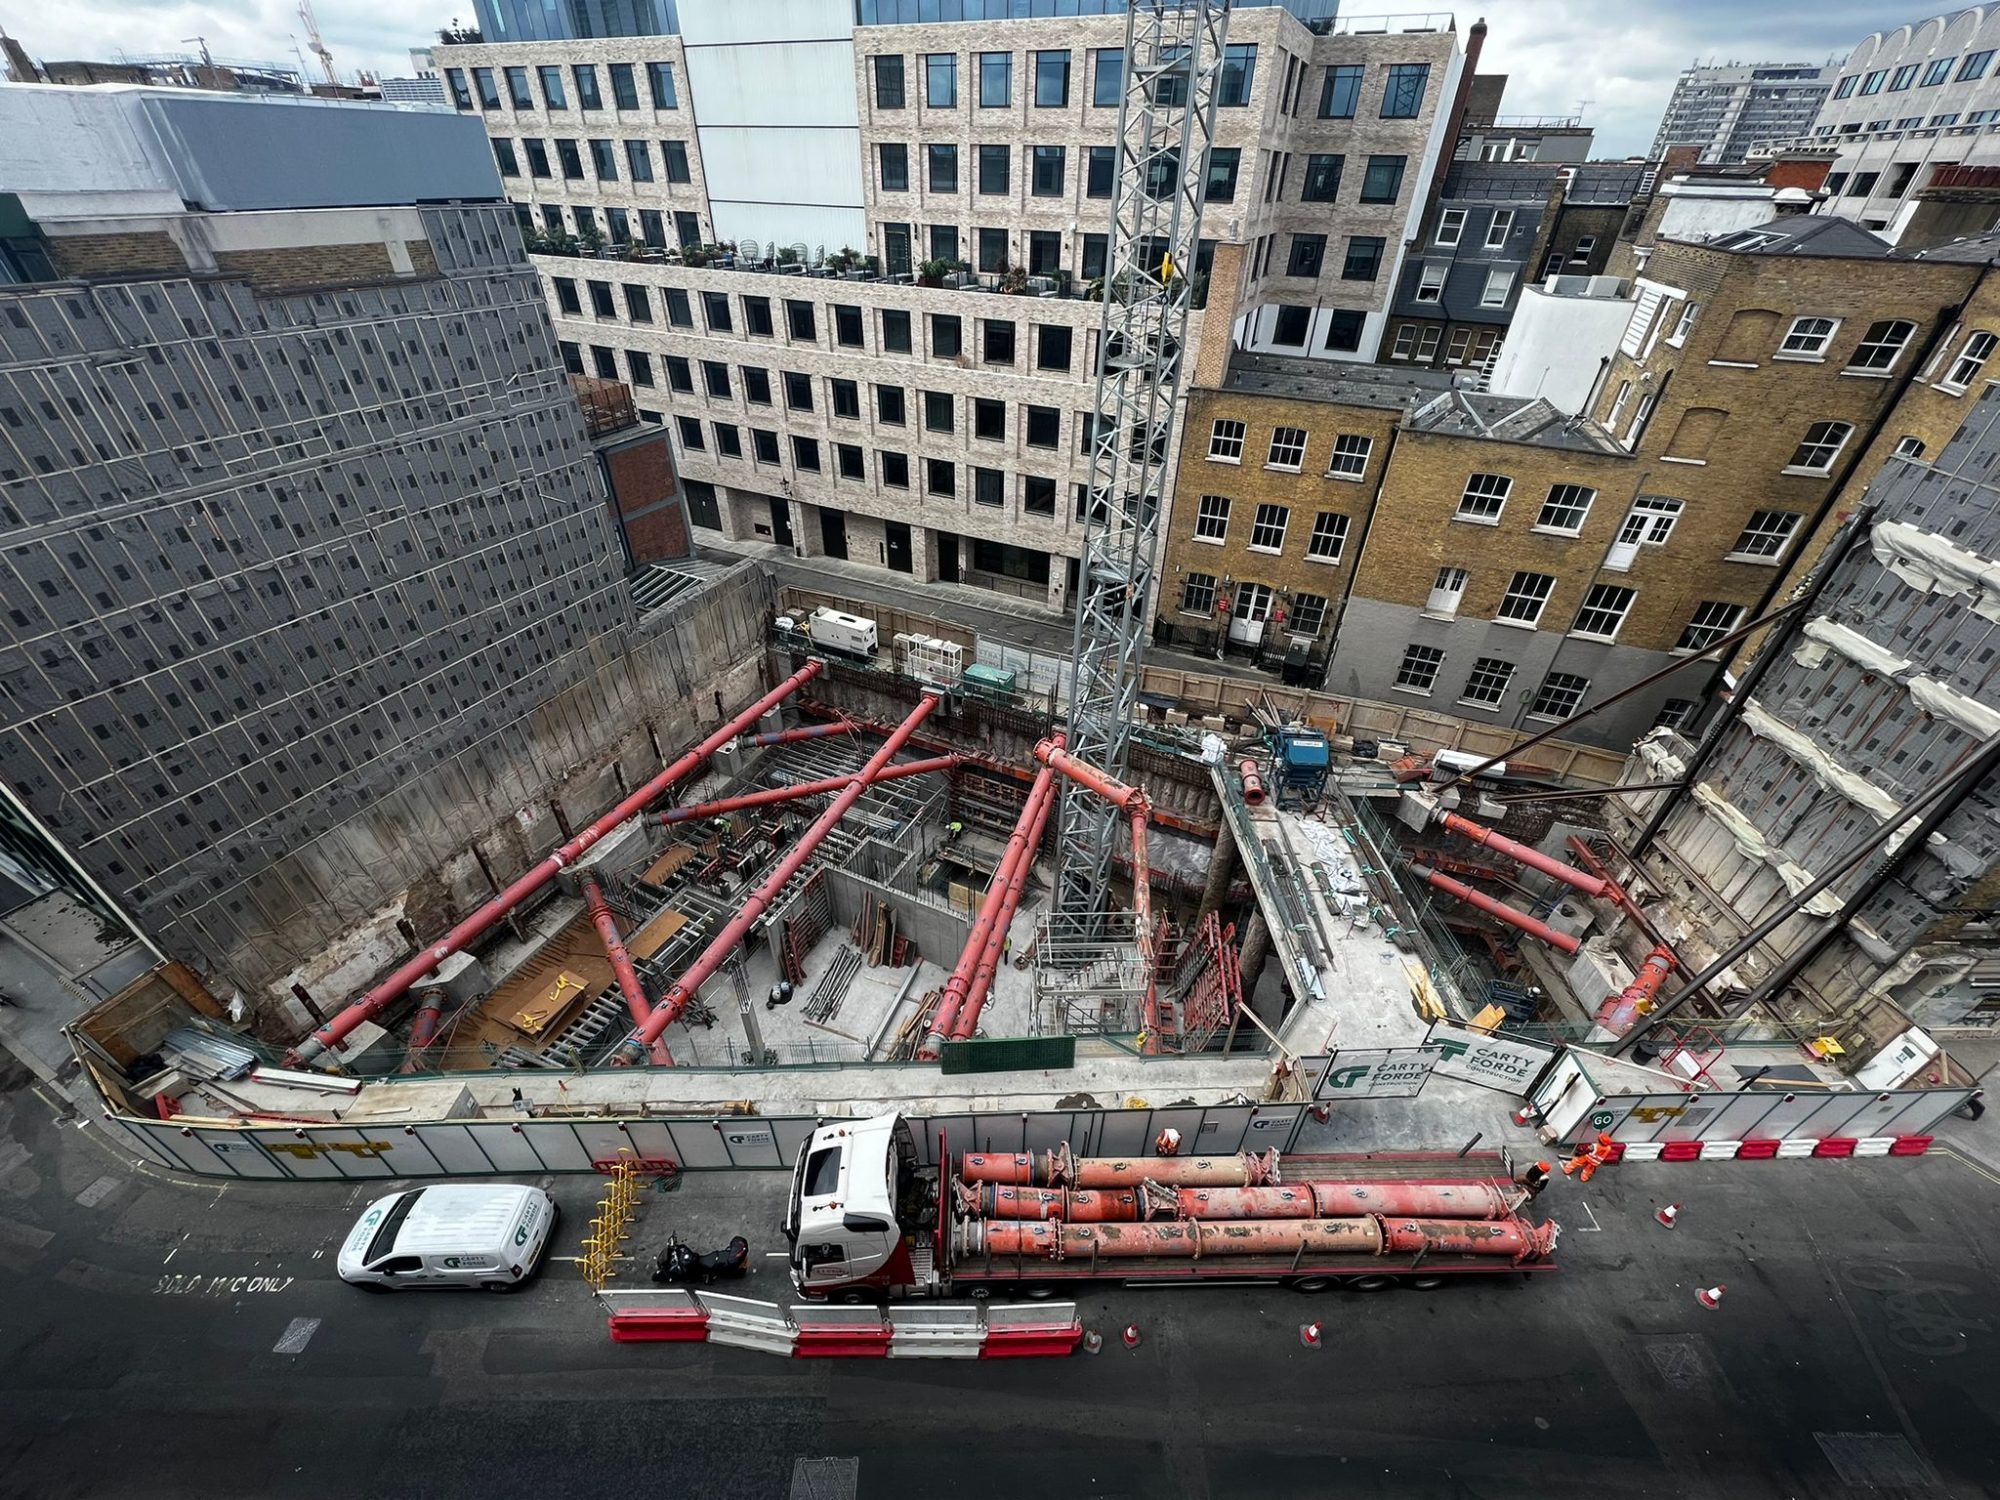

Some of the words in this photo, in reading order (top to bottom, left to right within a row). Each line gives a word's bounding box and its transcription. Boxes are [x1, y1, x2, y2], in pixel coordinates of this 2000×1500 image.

[1476, 1048, 1535, 1068] CARTY
[1377, 1062, 1429, 1072] CARTY
[1465, 1064, 1521, 1083] CONSTRUCTION
[1470, 1056, 1528, 1078] FORDE
[1372, 1072, 1424, 1081] FORDE
[1594, 1115, 1612, 1125] GO
[247, 1276, 294, 1292] ONLY
